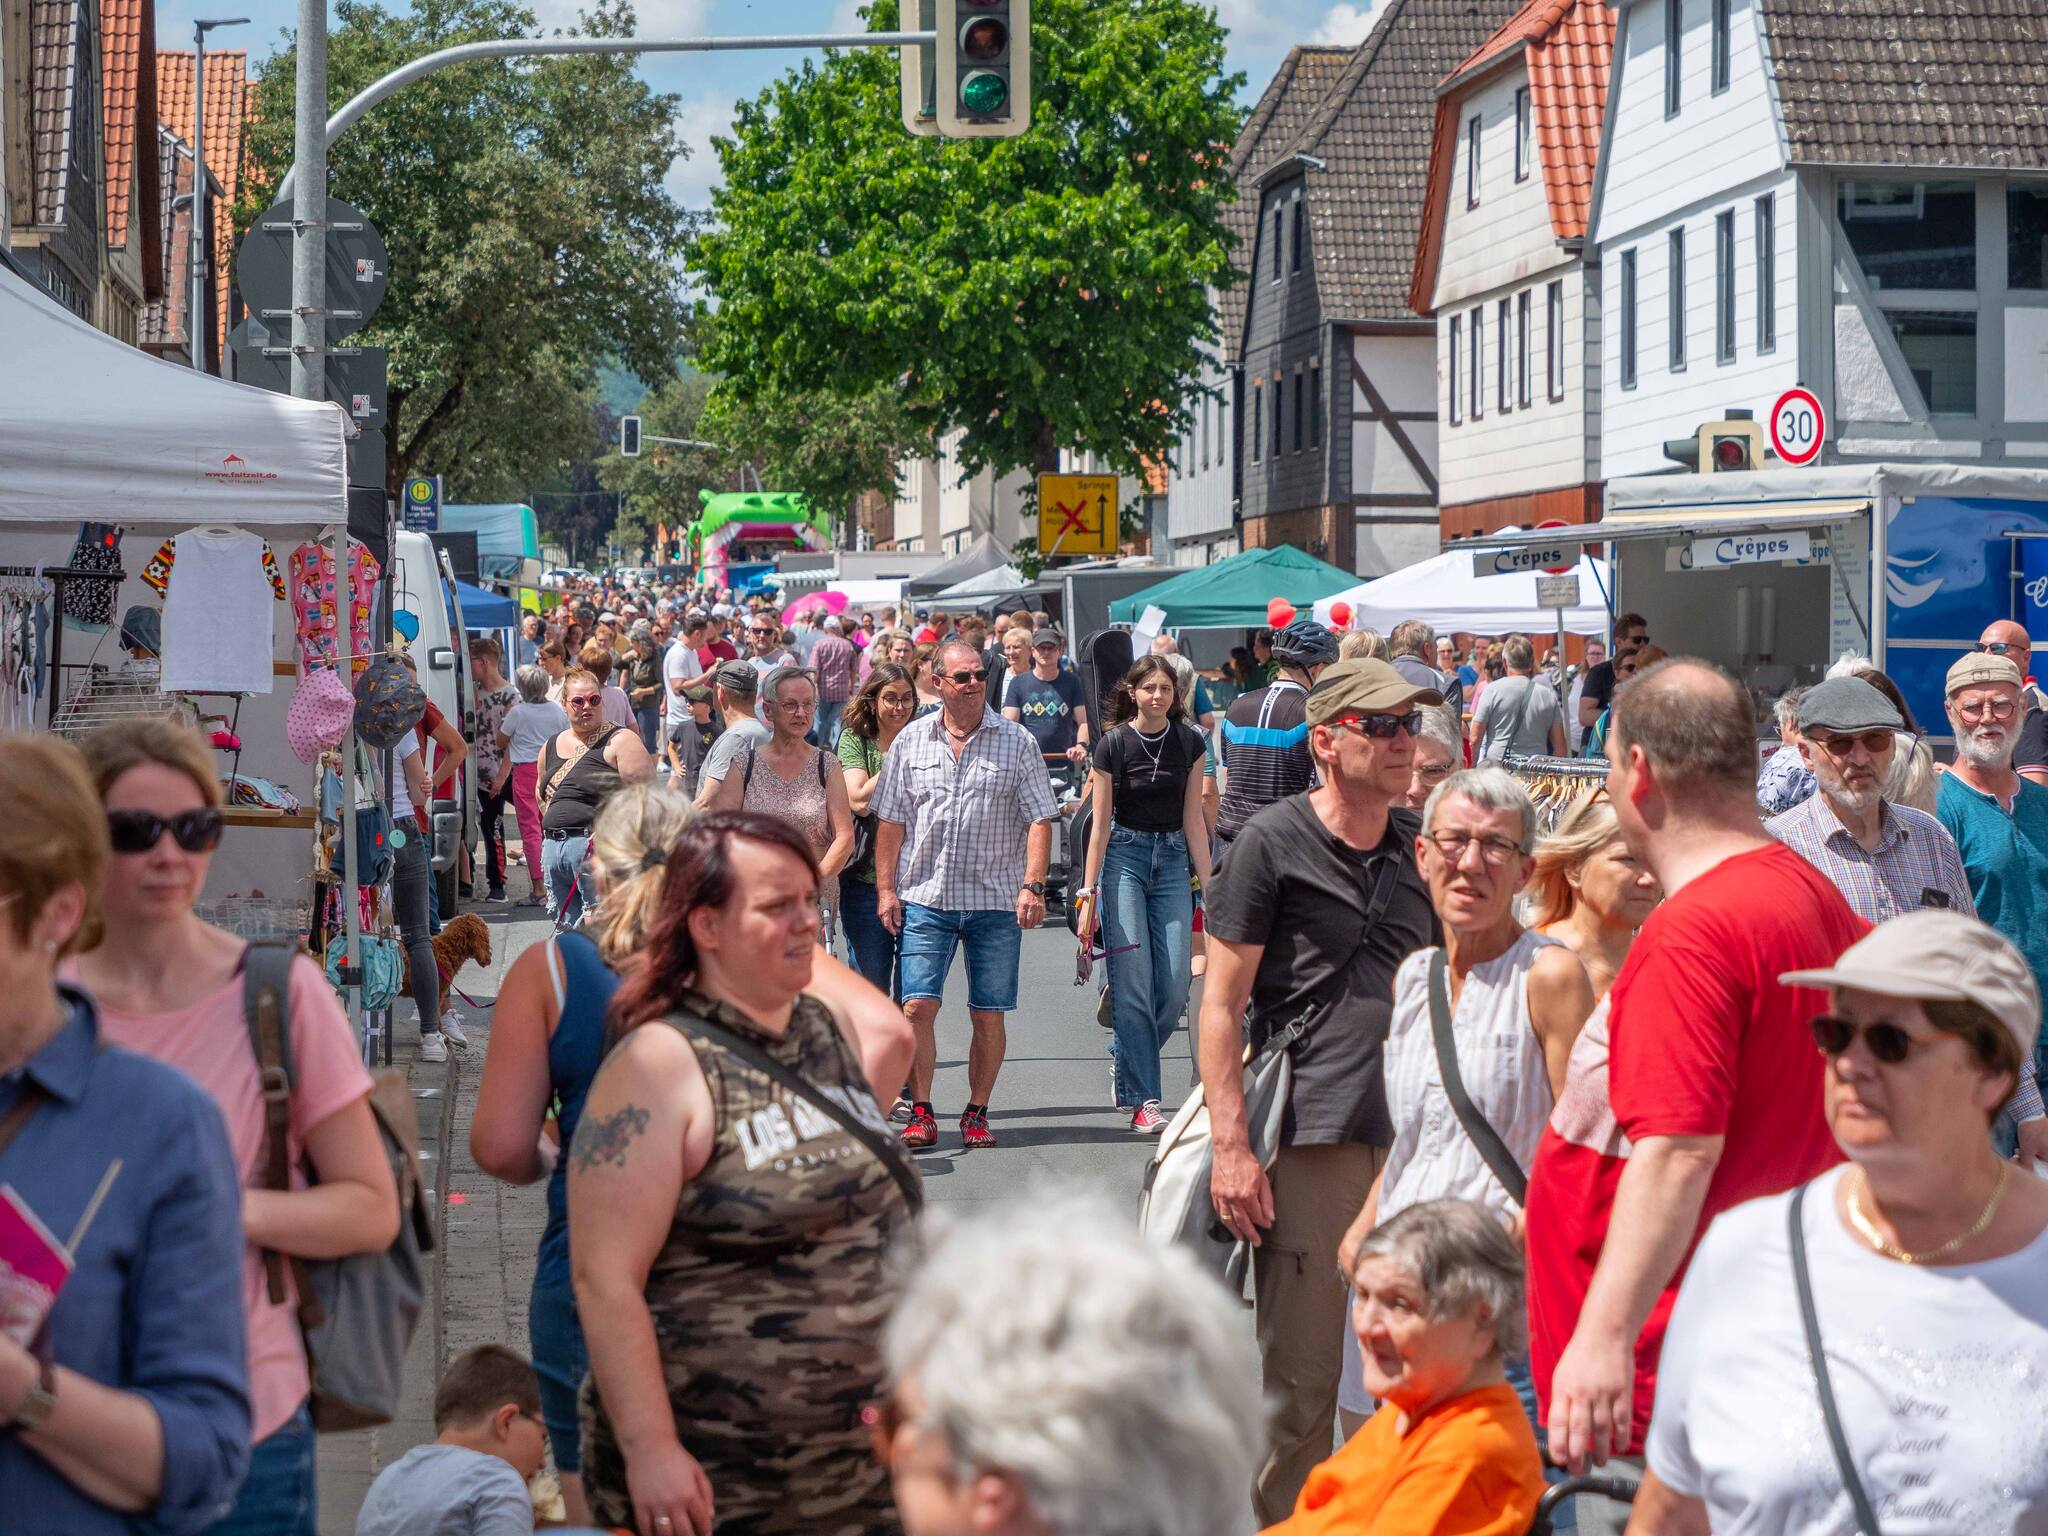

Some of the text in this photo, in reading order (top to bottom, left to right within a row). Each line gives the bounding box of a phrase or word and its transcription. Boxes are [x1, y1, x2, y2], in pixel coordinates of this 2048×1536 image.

[1781, 410, 1812, 443] 30
[1494, 549, 1562, 574] Crêpes
[1716, 537, 1789, 564] Crêpes
[735, 1102, 798, 1172] LOS
[1889, 1393, 1951, 1420] Strong
[1888, 1431, 1948, 1453] Smart
[1901, 1468, 1936, 1488] and
[1879, 1492, 1958, 1520] Beautiful
